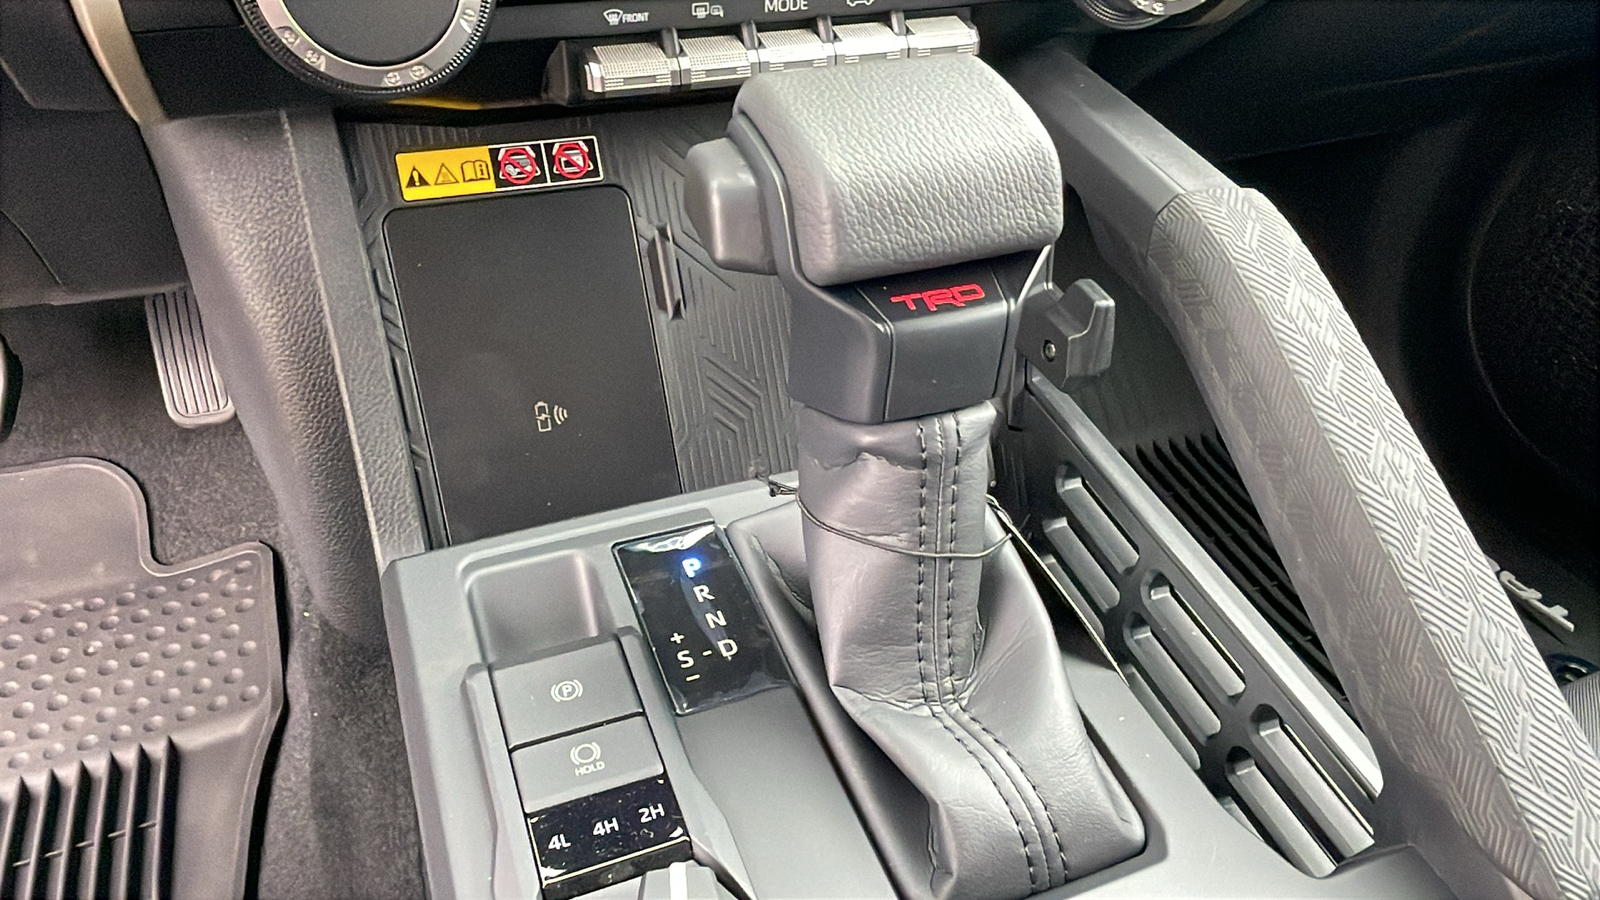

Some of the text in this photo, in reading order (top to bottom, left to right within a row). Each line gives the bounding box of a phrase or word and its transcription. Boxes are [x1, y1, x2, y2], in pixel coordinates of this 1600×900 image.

[764, 0, 809, 13] MODE
[622, 11, 649, 23] FRONT
[890, 283, 985, 311] TRD
[682, 558, 701, 578] P
[693, 585, 715, 602] R
[705, 610, 727, 629] N
[717, 638, 738, 657] D
[676, 650, 695, 668] S
[575, 761, 605, 776] HOLD
[548, 803, 665, 850] 4L 4H 2H
